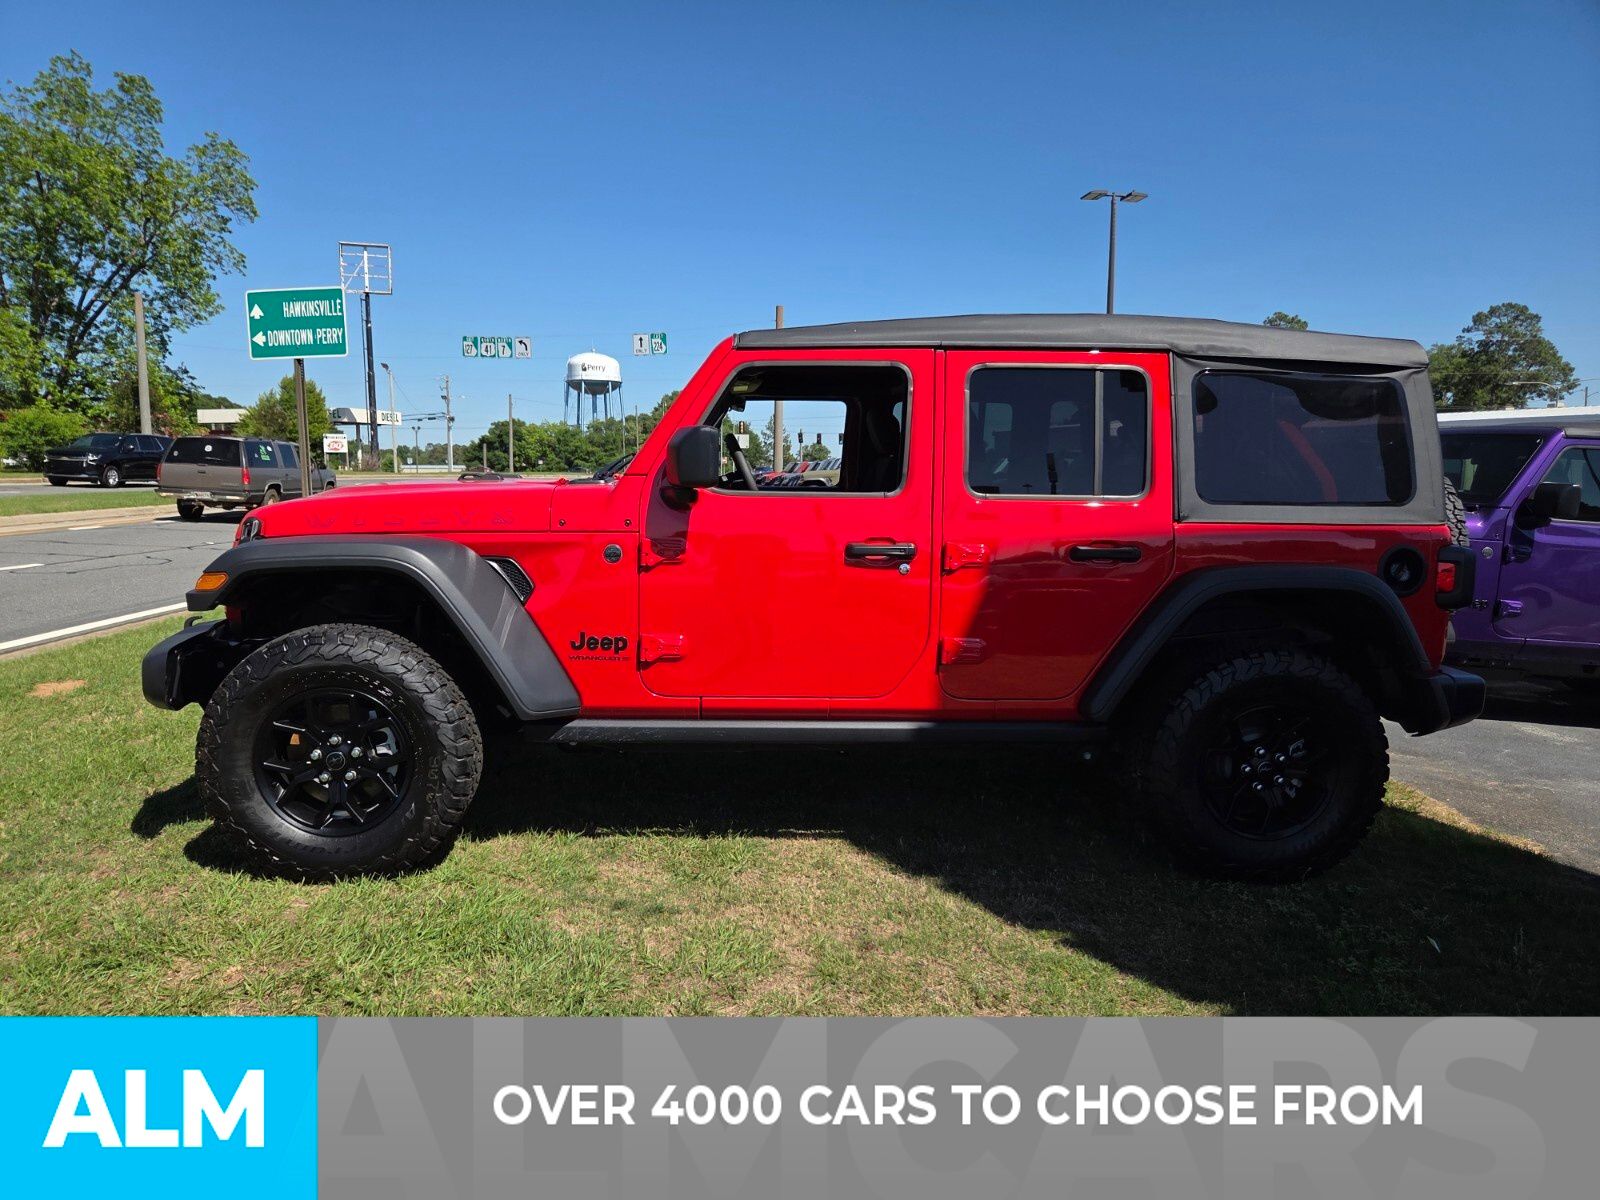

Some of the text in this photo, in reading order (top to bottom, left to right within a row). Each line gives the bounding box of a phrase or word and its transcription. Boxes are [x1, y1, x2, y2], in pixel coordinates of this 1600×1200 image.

[282, 298, 343, 318] HAWKINSVILLE
[267, 327, 343, 347] DOWNTOWN PERRY
[484, 344, 492, 355] 41
[501, 344, 506, 356] 7
[653, 341, 663, 352] 224
[587, 363, 606, 373] Perry
[569, 631, 628, 654] Jeep
